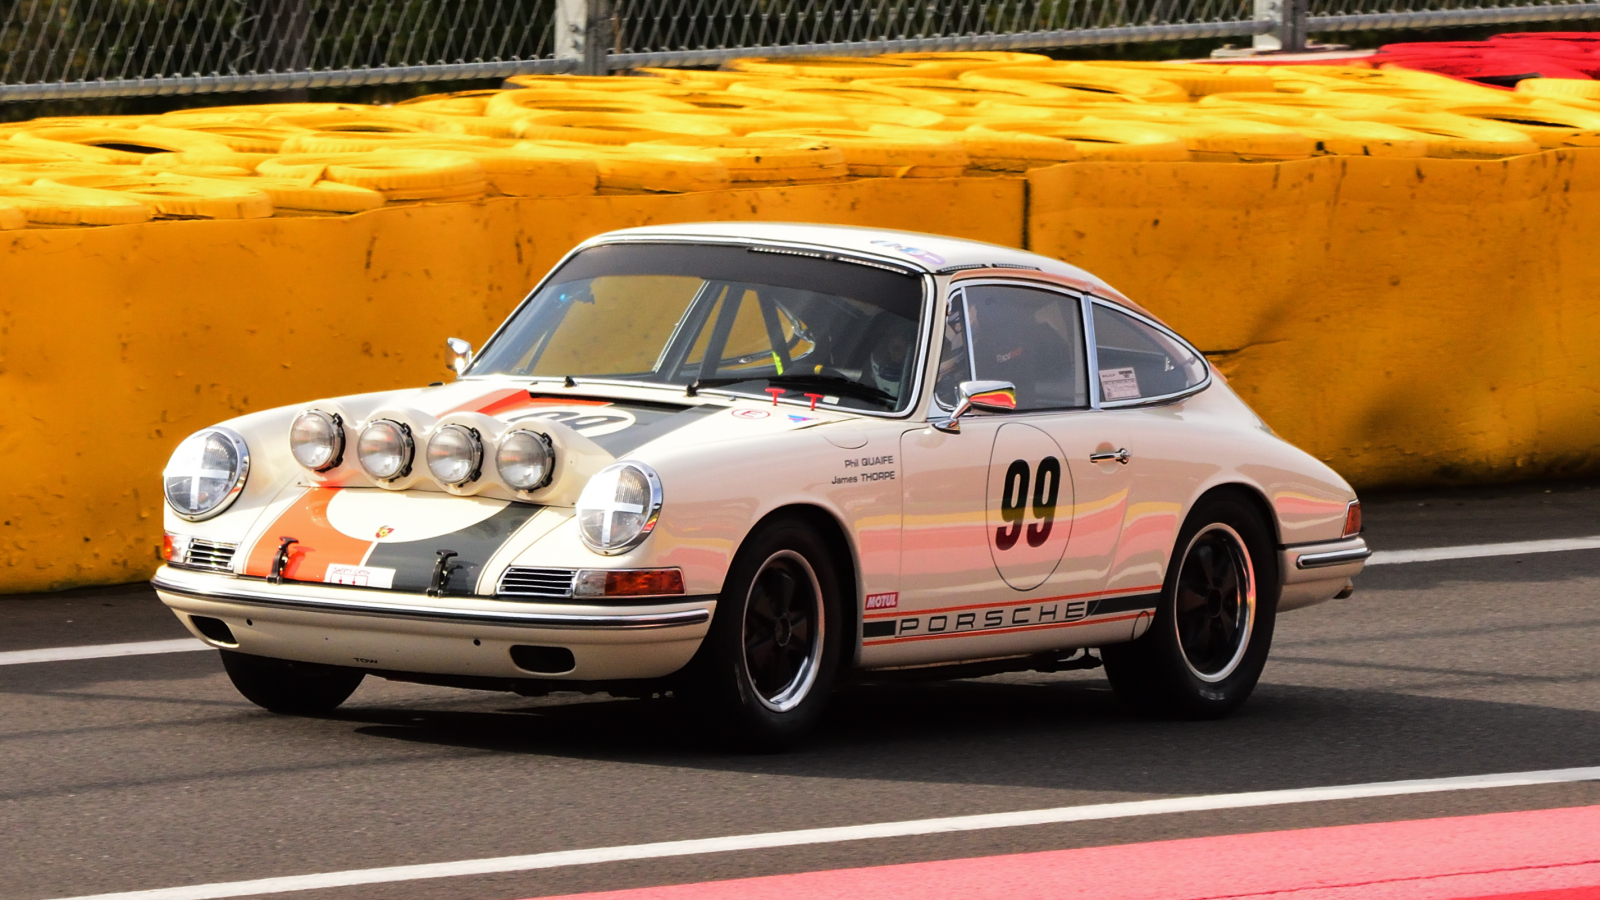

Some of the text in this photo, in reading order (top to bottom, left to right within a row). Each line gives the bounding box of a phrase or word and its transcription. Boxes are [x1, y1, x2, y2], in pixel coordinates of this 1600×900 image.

[845, 455, 894, 468] Phil QUAIFE
[831, 471, 895, 485] James THORPE
[995, 455, 1061, 551] 99
[866, 593, 896, 608] MOTUL
[899, 601, 1086, 635] PORSCHE
